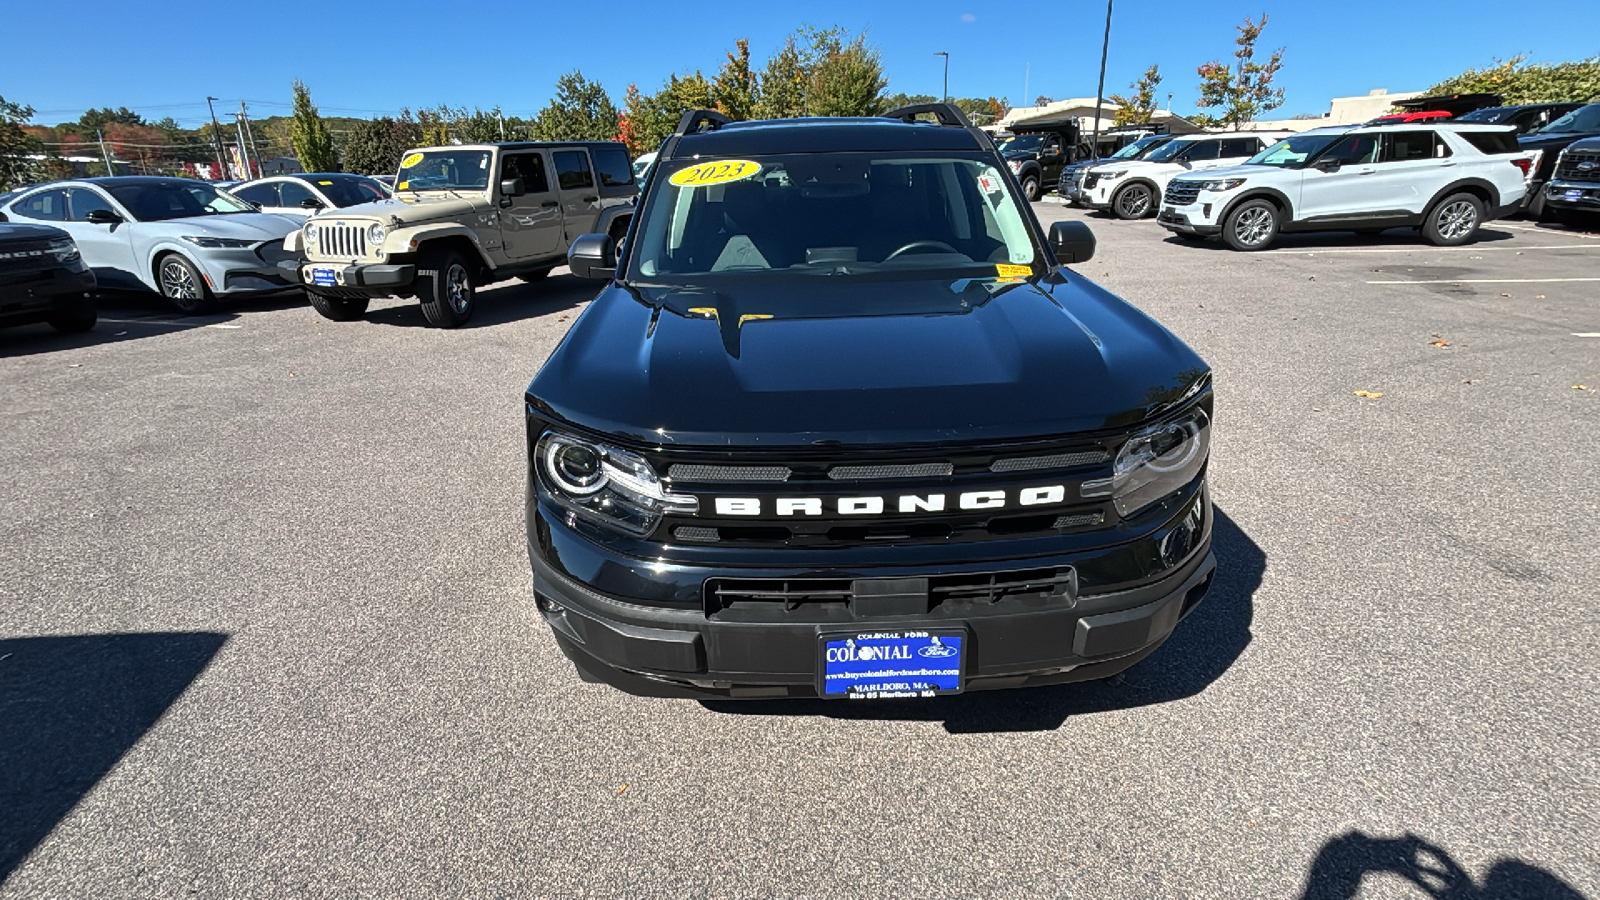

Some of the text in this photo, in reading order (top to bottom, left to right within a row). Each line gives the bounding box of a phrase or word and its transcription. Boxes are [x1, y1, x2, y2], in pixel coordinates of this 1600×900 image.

[683, 163, 746, 184] 2023
[714, 484, 1065, 516] BRONCO
[826, 645, 912, 662] COLONIAL
[879, 690, 918, 699] Marlboro
[921, 690, 936, 698] MA
[912, 682, 929, 690] MA
